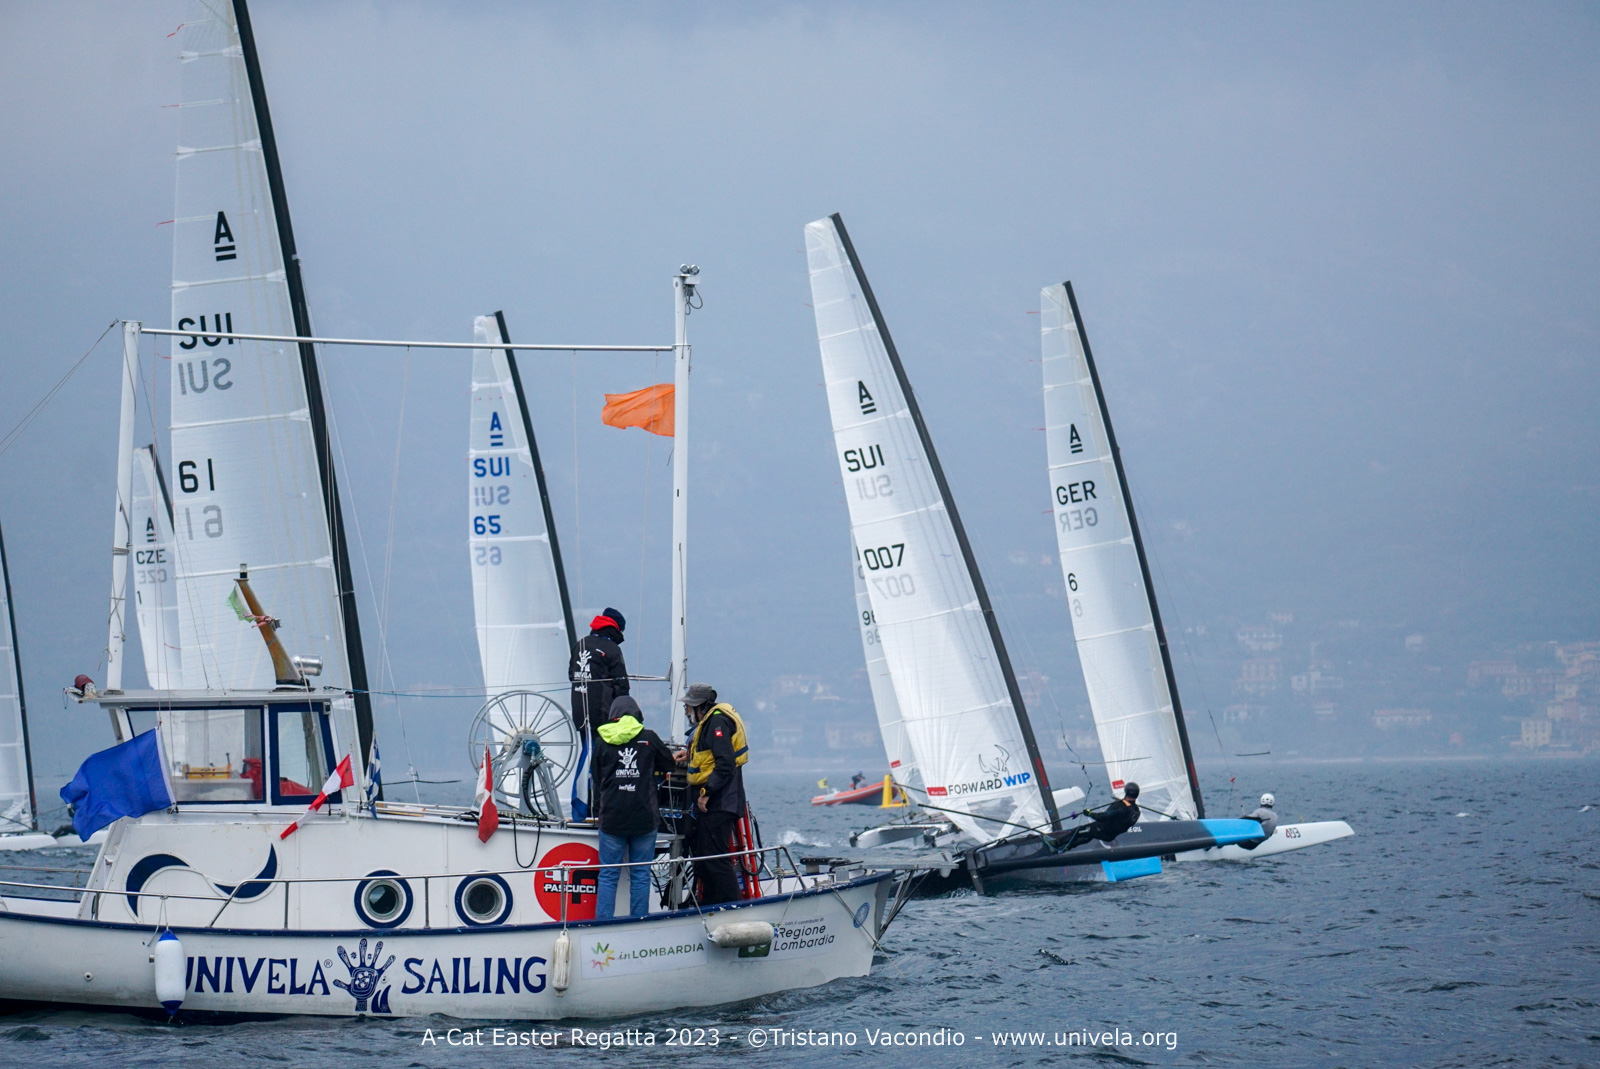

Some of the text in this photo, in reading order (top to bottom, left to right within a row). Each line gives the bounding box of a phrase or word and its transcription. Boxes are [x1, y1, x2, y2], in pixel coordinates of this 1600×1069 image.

[178, 312, 234, 350] SUI
[473, 457, 511, 478] SUI
[843, 444, 885, 472] SUI
[178, 458, 216, 493] 61
[1056, 480, 1097, 506] GER
[473, 515, 502, 535] 65
[136, 549, 167, 565] CZE
[863, 543, 905, 571] 007
[1067, 572, 1078, 592] 6
[137, 591, 142, 605] 1
[948, 772, 1031, 795] FORWARD WIP
[544, 883, 597, 894] PASCUCCI
[777, 925, 826, 940] Regione
[774, 935, 835, 952] Lombardia
[401, 956, 548, 995] SAILING
